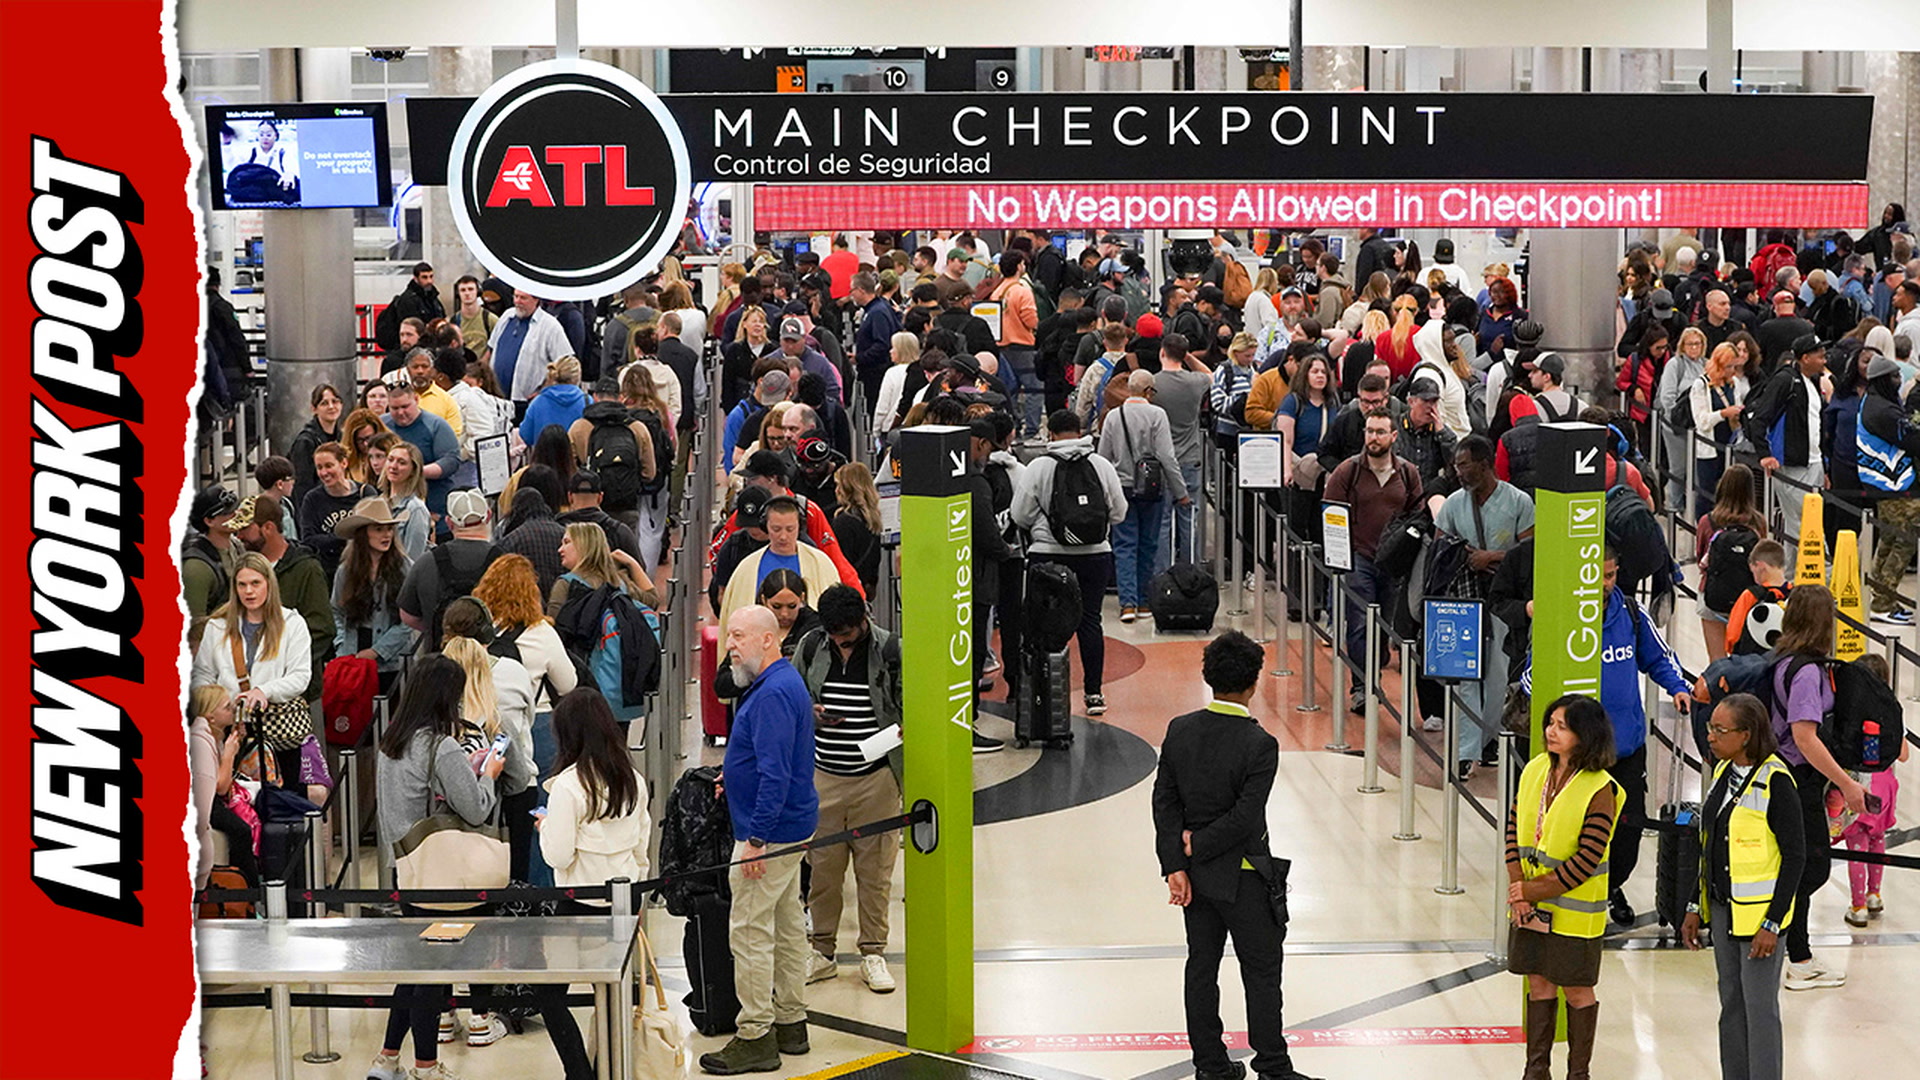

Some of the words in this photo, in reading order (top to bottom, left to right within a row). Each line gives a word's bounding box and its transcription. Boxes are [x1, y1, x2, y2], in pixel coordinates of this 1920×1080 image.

[886, 71, 906, 87] 10
[995, 70, 1009, 87] 9
[714, 106, 898, 147] MAIN
[952, 105, 1446, 146] CHECKPOINT
[304, 152, 317, 160] Do
[318, 152, 331, 160] not
[333, 151, 372, 159] overstack
[316, 160, 335, 169] your
[336, 160, 373, 168] property
[714, 153, 809, 175] Control
[818, 153, 851, 175] de
[859, 152, 990, 179] Seguridad
[485, 145, 655, 207] ATL
[967, 189, 1021, 223] No
[1032, 189, 1218, 229] Weapons
[1227, 188, 1378, 222] Allowed
[1393, 188, 1424, 222] in
[1438, 187, 1662, 229] Checkpoint!
[1804, 563, 1819, 571] WET
[949, 545, 972, 667] Gates
[1566, 543, 1601, 663] Gates
[1563, 678, 1598, 701] ll
[948, 680, 972, 731] All
[1088, 1033, 1233, 1043] FIREARS
[1364, 1028, 1509, 1036] FIREARMS
